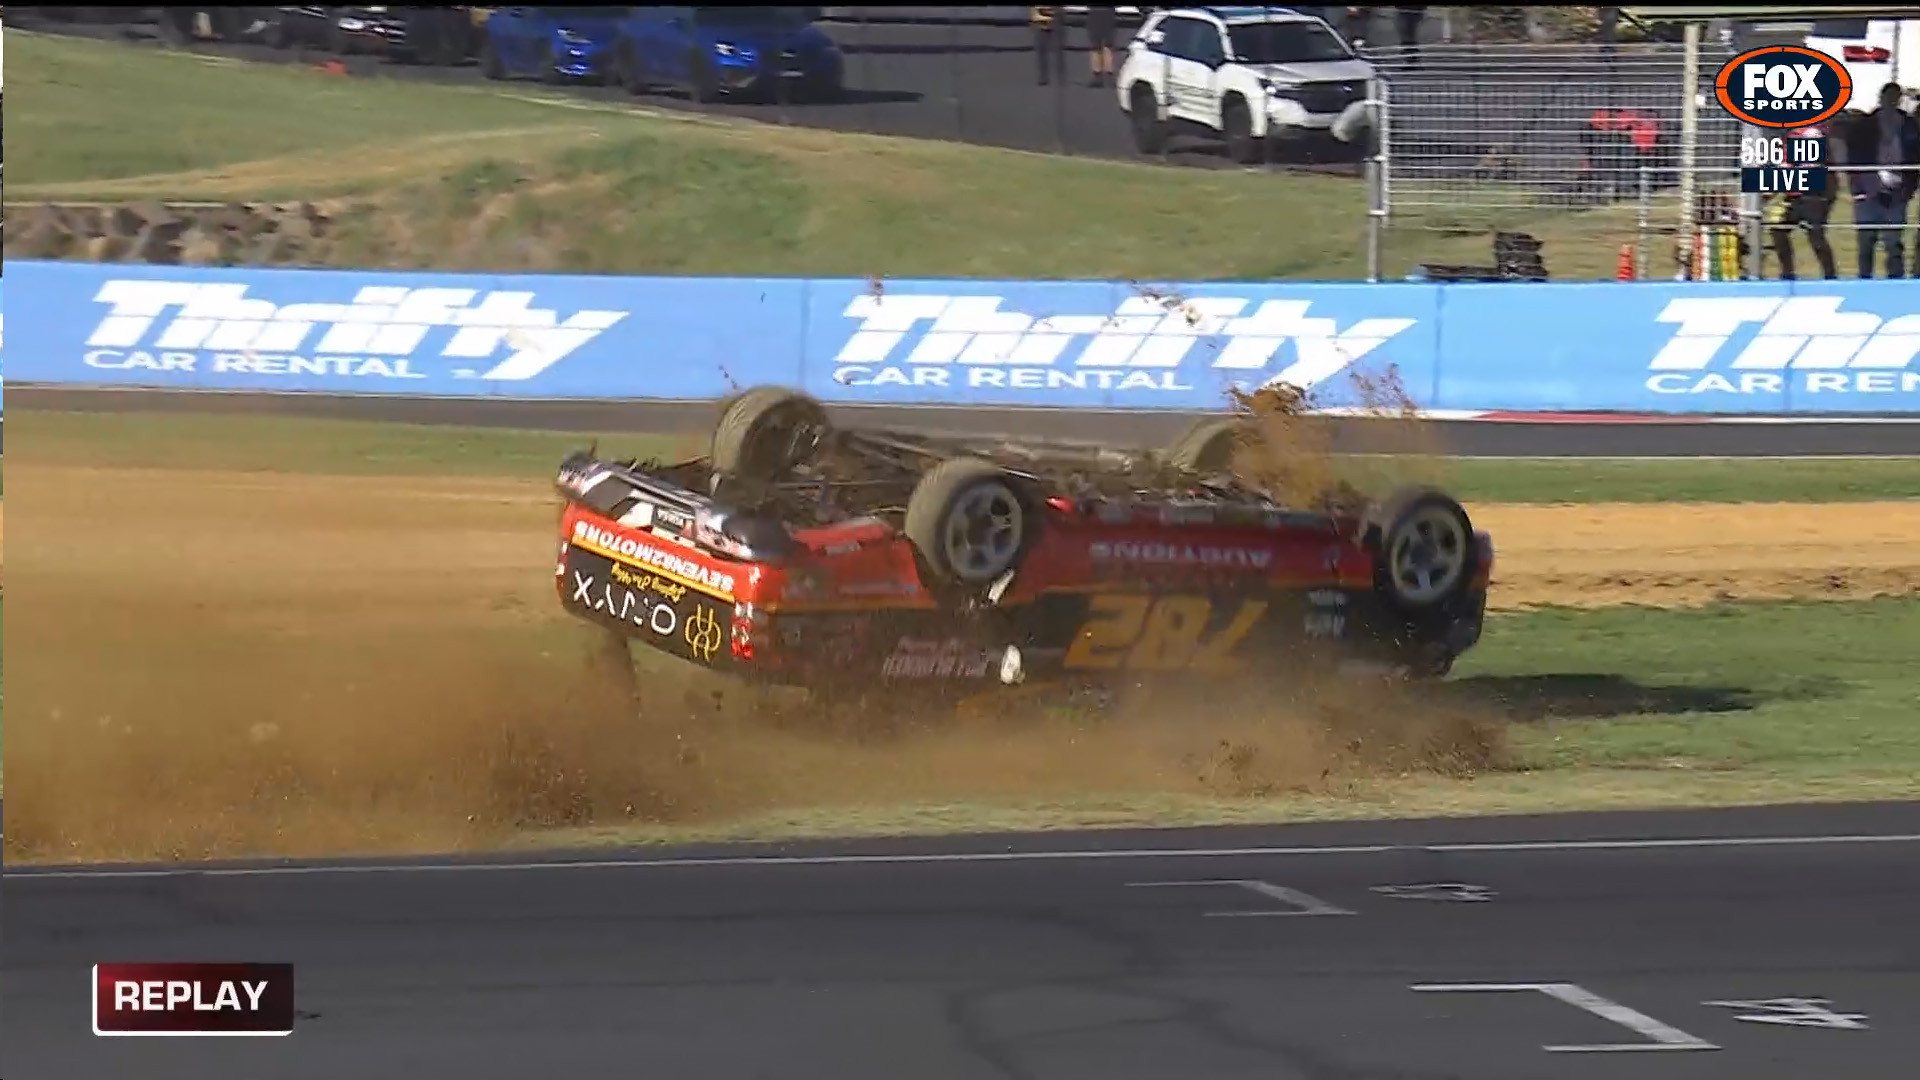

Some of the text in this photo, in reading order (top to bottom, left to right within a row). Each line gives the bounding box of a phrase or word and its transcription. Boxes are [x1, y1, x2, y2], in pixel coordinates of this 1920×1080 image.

[85, 280, 630, 380] Thrifty
[833, 294, 1418, 388] Thrifty
[83, 350, 428, 379] CAR RENTAL
[833, 366, 1195, 391] CAR RENTAL
[1645, 373, 1782, 393] CAR
[574, 520, 734, 592] SEVEN82MOTORS
